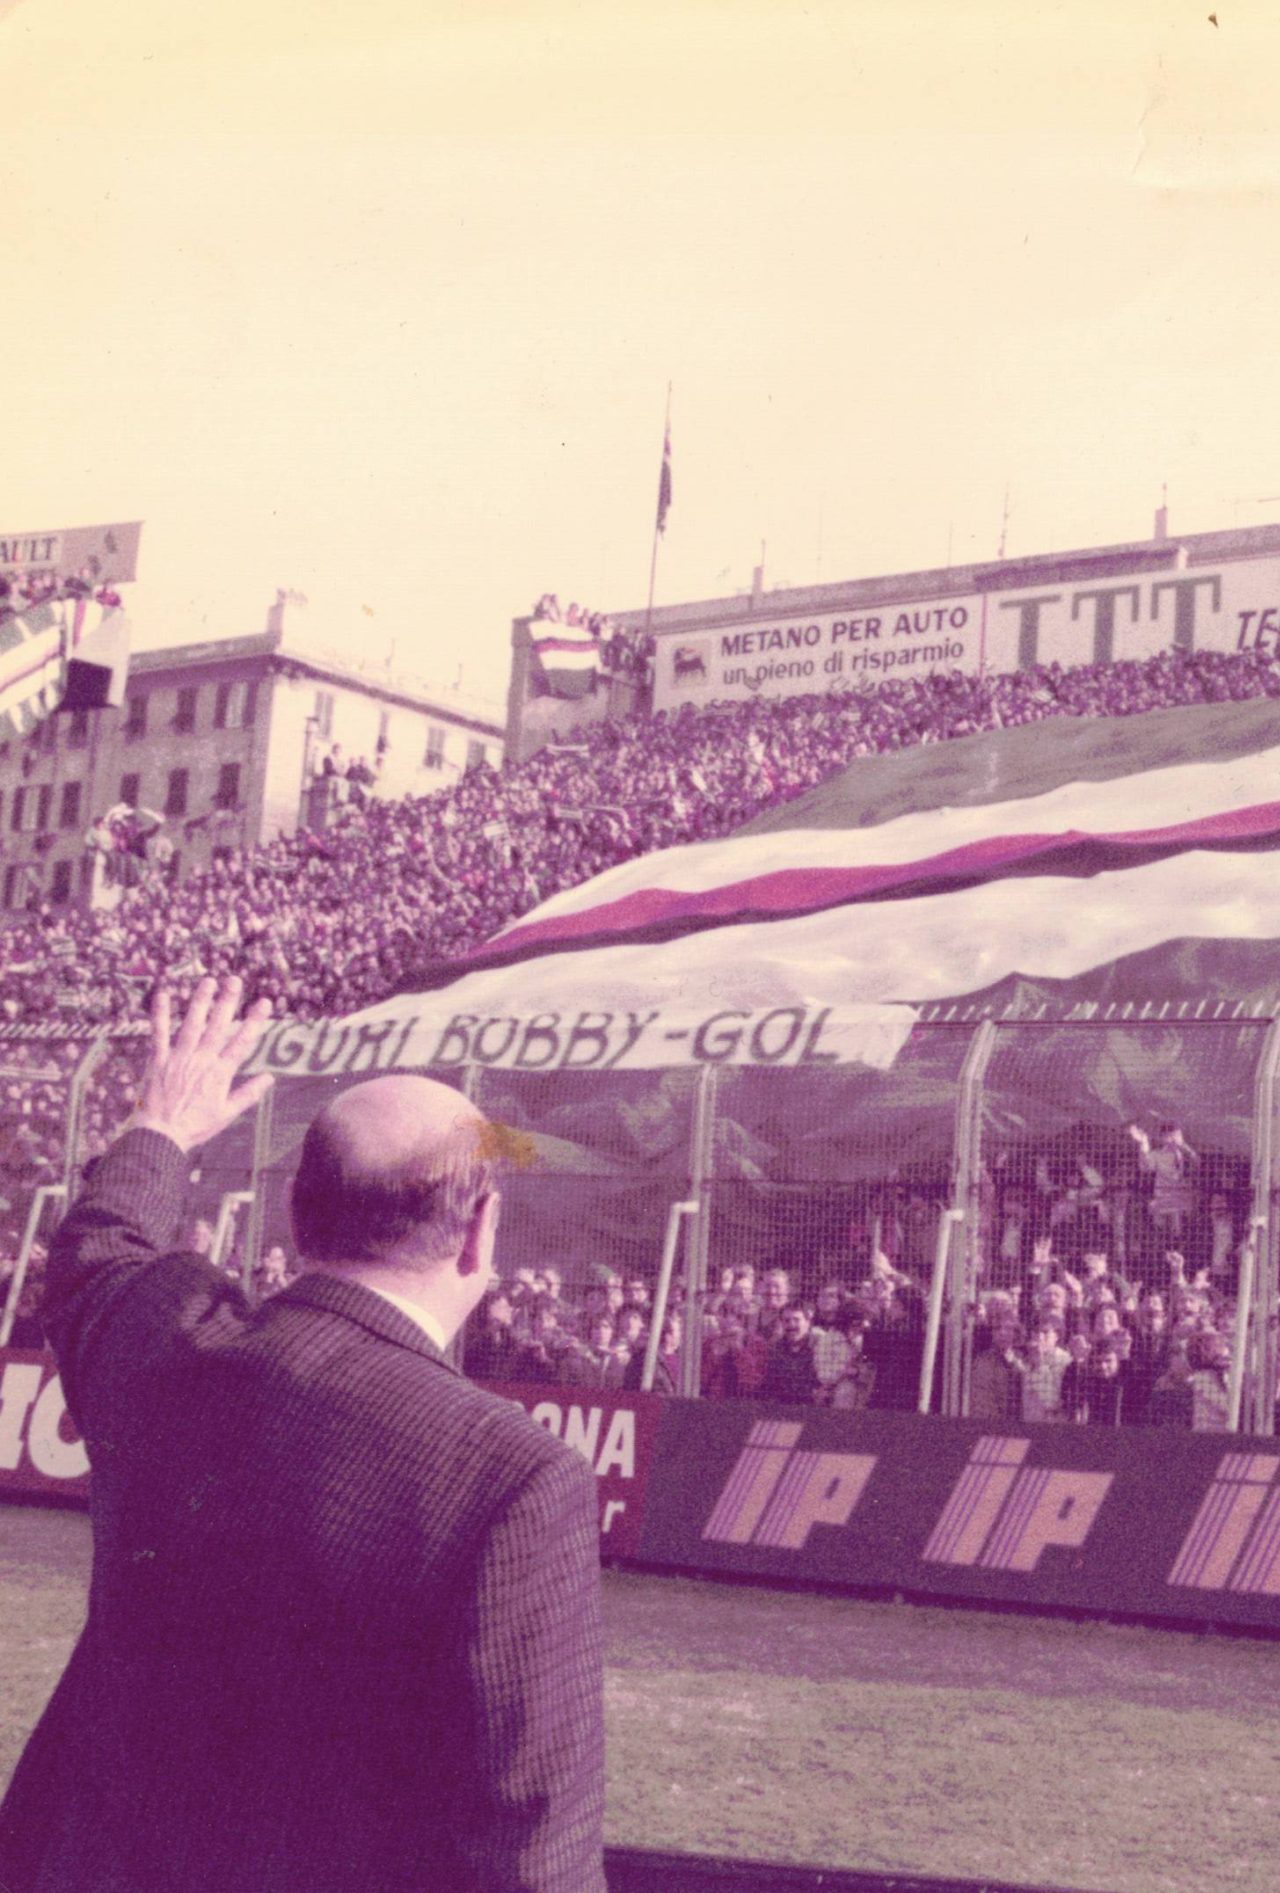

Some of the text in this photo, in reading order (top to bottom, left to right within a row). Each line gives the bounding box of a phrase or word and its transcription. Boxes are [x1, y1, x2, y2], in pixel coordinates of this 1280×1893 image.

[721, 606, 968, 656] METANO PER AUTO
[723, 637, 965, 685] un pieno di risparmio
